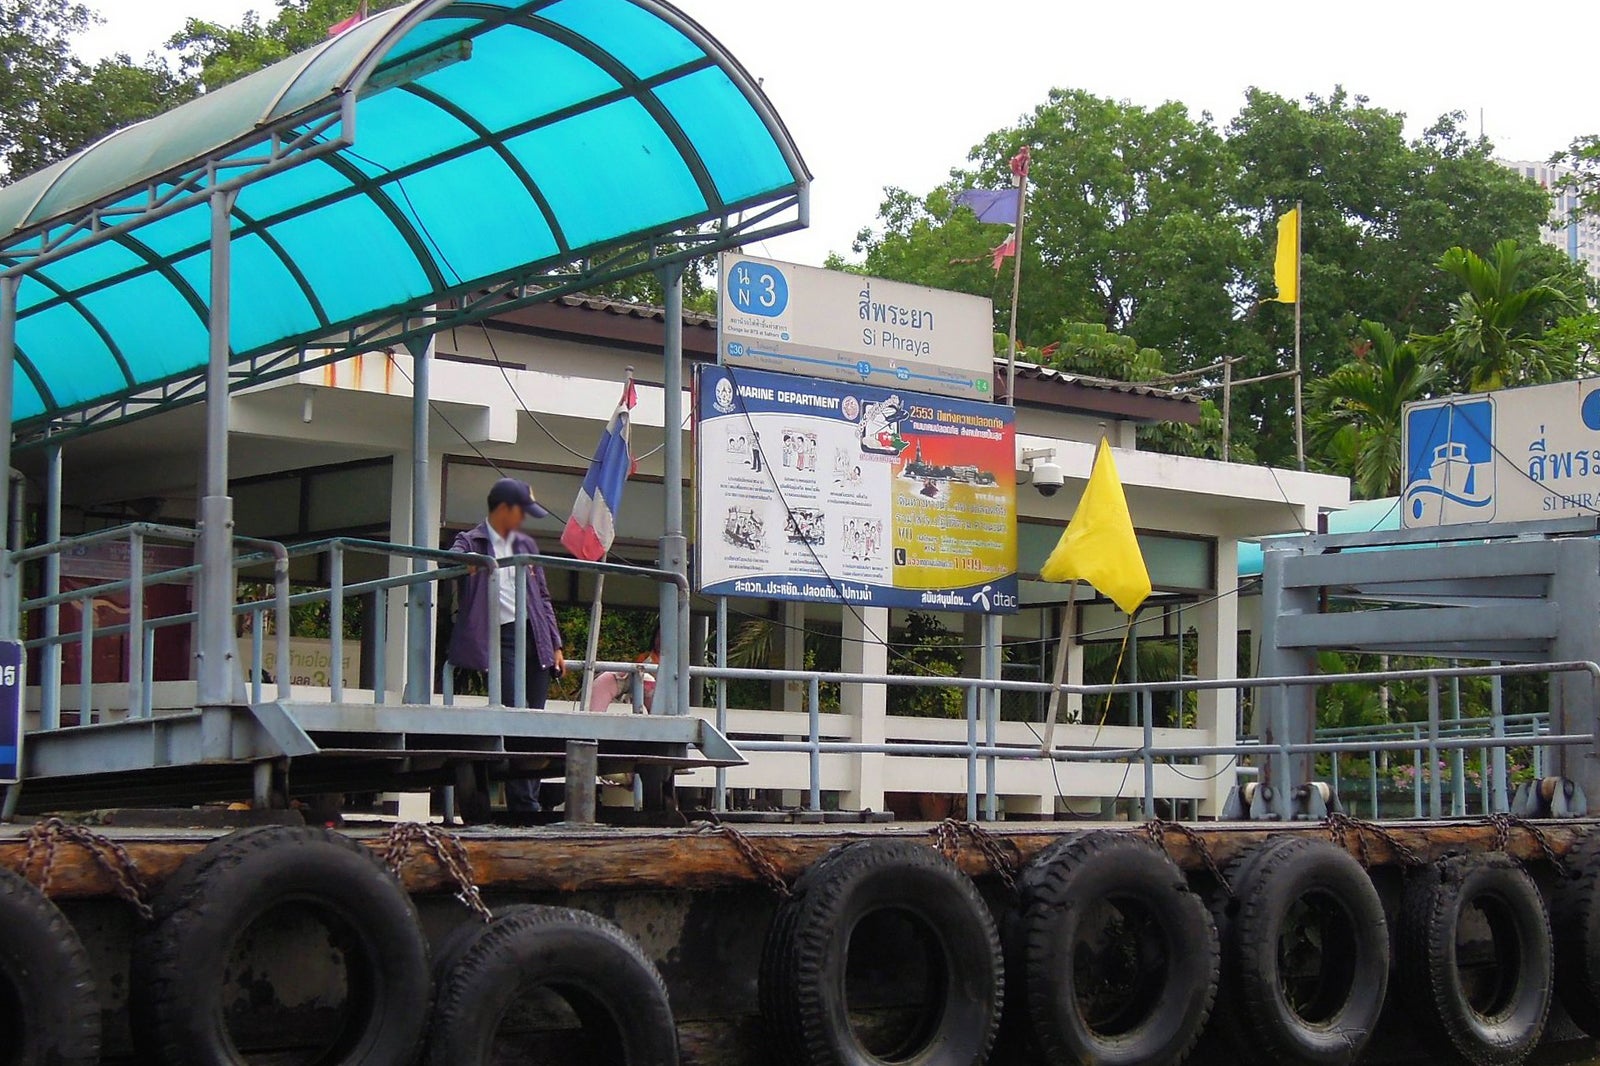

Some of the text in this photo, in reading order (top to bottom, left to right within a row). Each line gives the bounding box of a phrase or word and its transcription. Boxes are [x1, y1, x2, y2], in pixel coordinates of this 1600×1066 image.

[737, 267, 750, 285] น
[739, 288, 750, 306] N
[759, 274, 776, 307] 3
[859, 282, 934, 331] สี่พระยา
[863, 328, 930, 357] Si Phraya
[736, 385, 840, 409] MARINE DEPARTMENT
[909, 405, 934, 420] 2553
[1543, 496, 1556, 511] SI
[954, 557, 982, 571] 1199
[992, 593, 1017, 608] dtac
